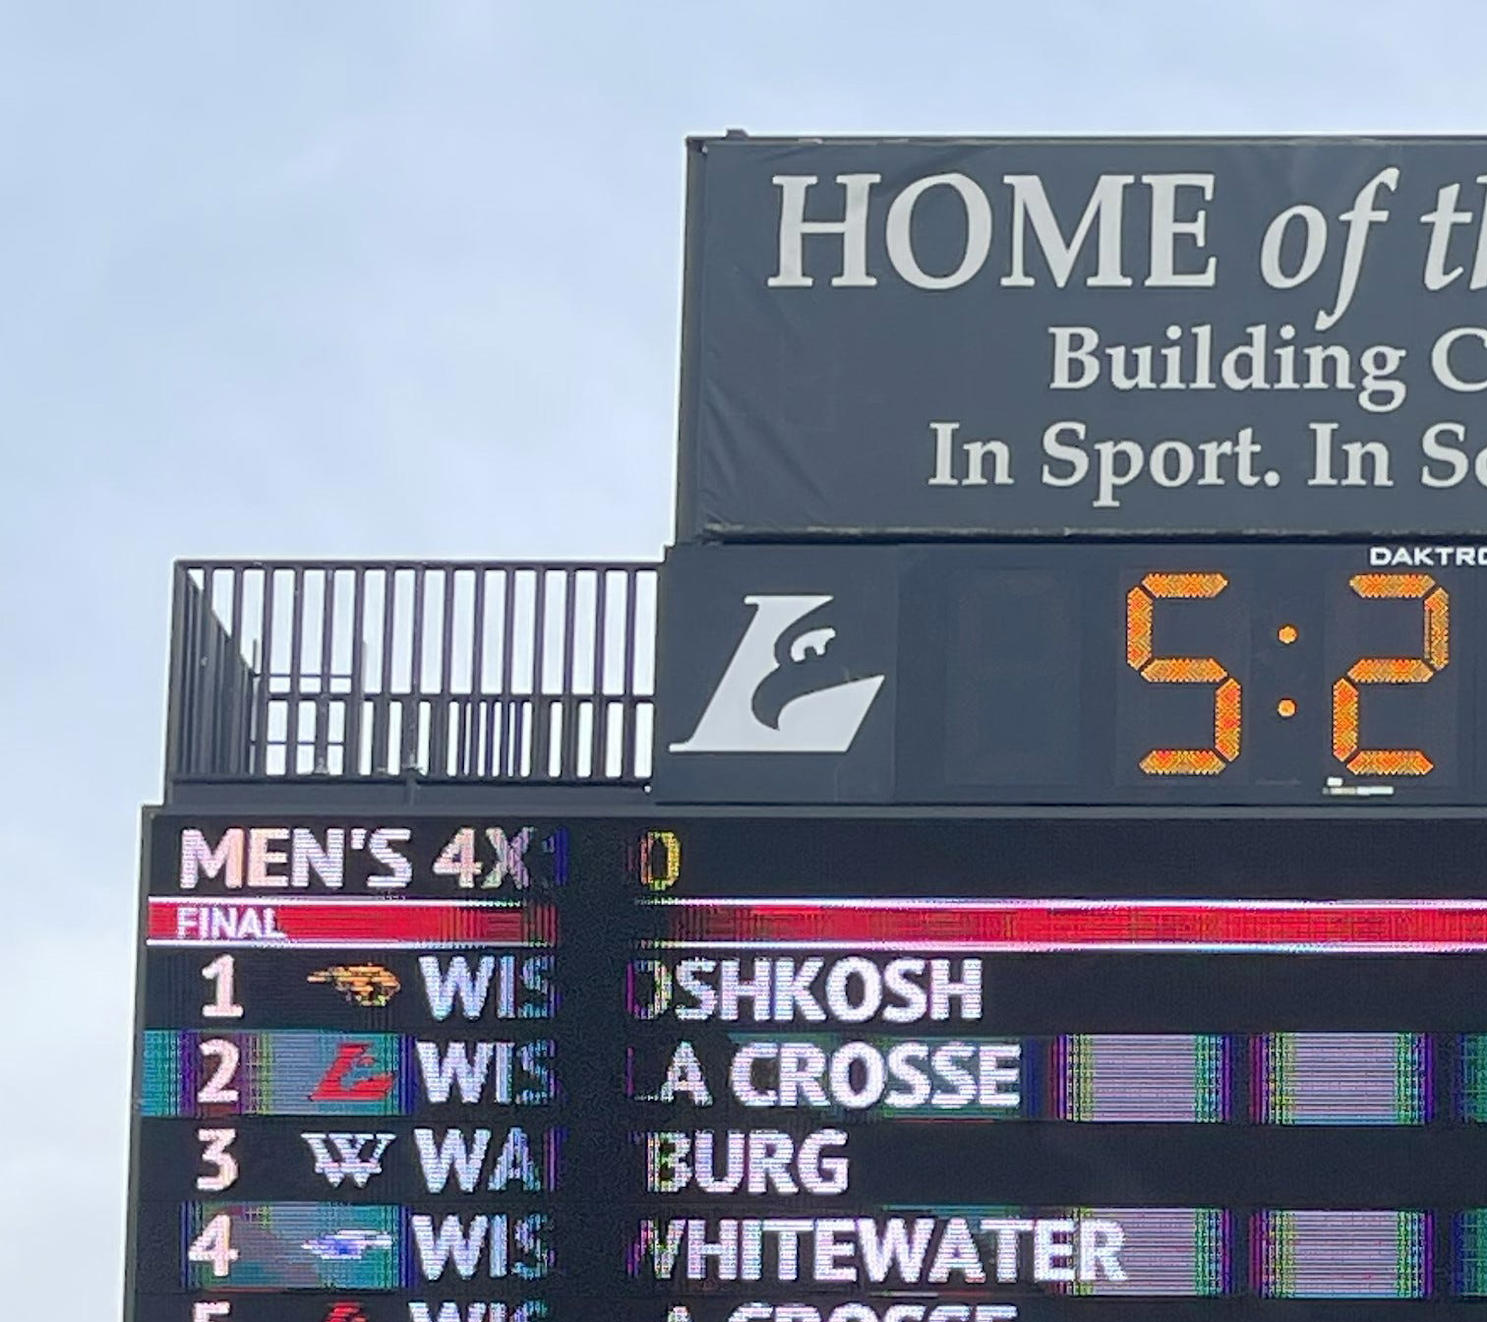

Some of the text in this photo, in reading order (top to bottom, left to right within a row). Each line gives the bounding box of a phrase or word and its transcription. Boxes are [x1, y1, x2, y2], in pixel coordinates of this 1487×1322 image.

[767, 173, 1218, 291] HOME
[1260, 166, 1398, 329] of
[1048, 326, 1408, 409] Building
[928, 422, 1012, 489] In
[1040, 420, 1281, 507] Sport.
[1308, 424, 1391, 489] In
[181, 828, 413, 889] MEN'S
[176, 906, 287, 939] FINAL
[202, 955, 243, 1018] 1
[197, 1039, 240, 1104] 2
[729, 1041, 1022, 1109] CROSSE
[196, 1128, 239, 1191] 3
[188, 1214, 239, 1277] 4
